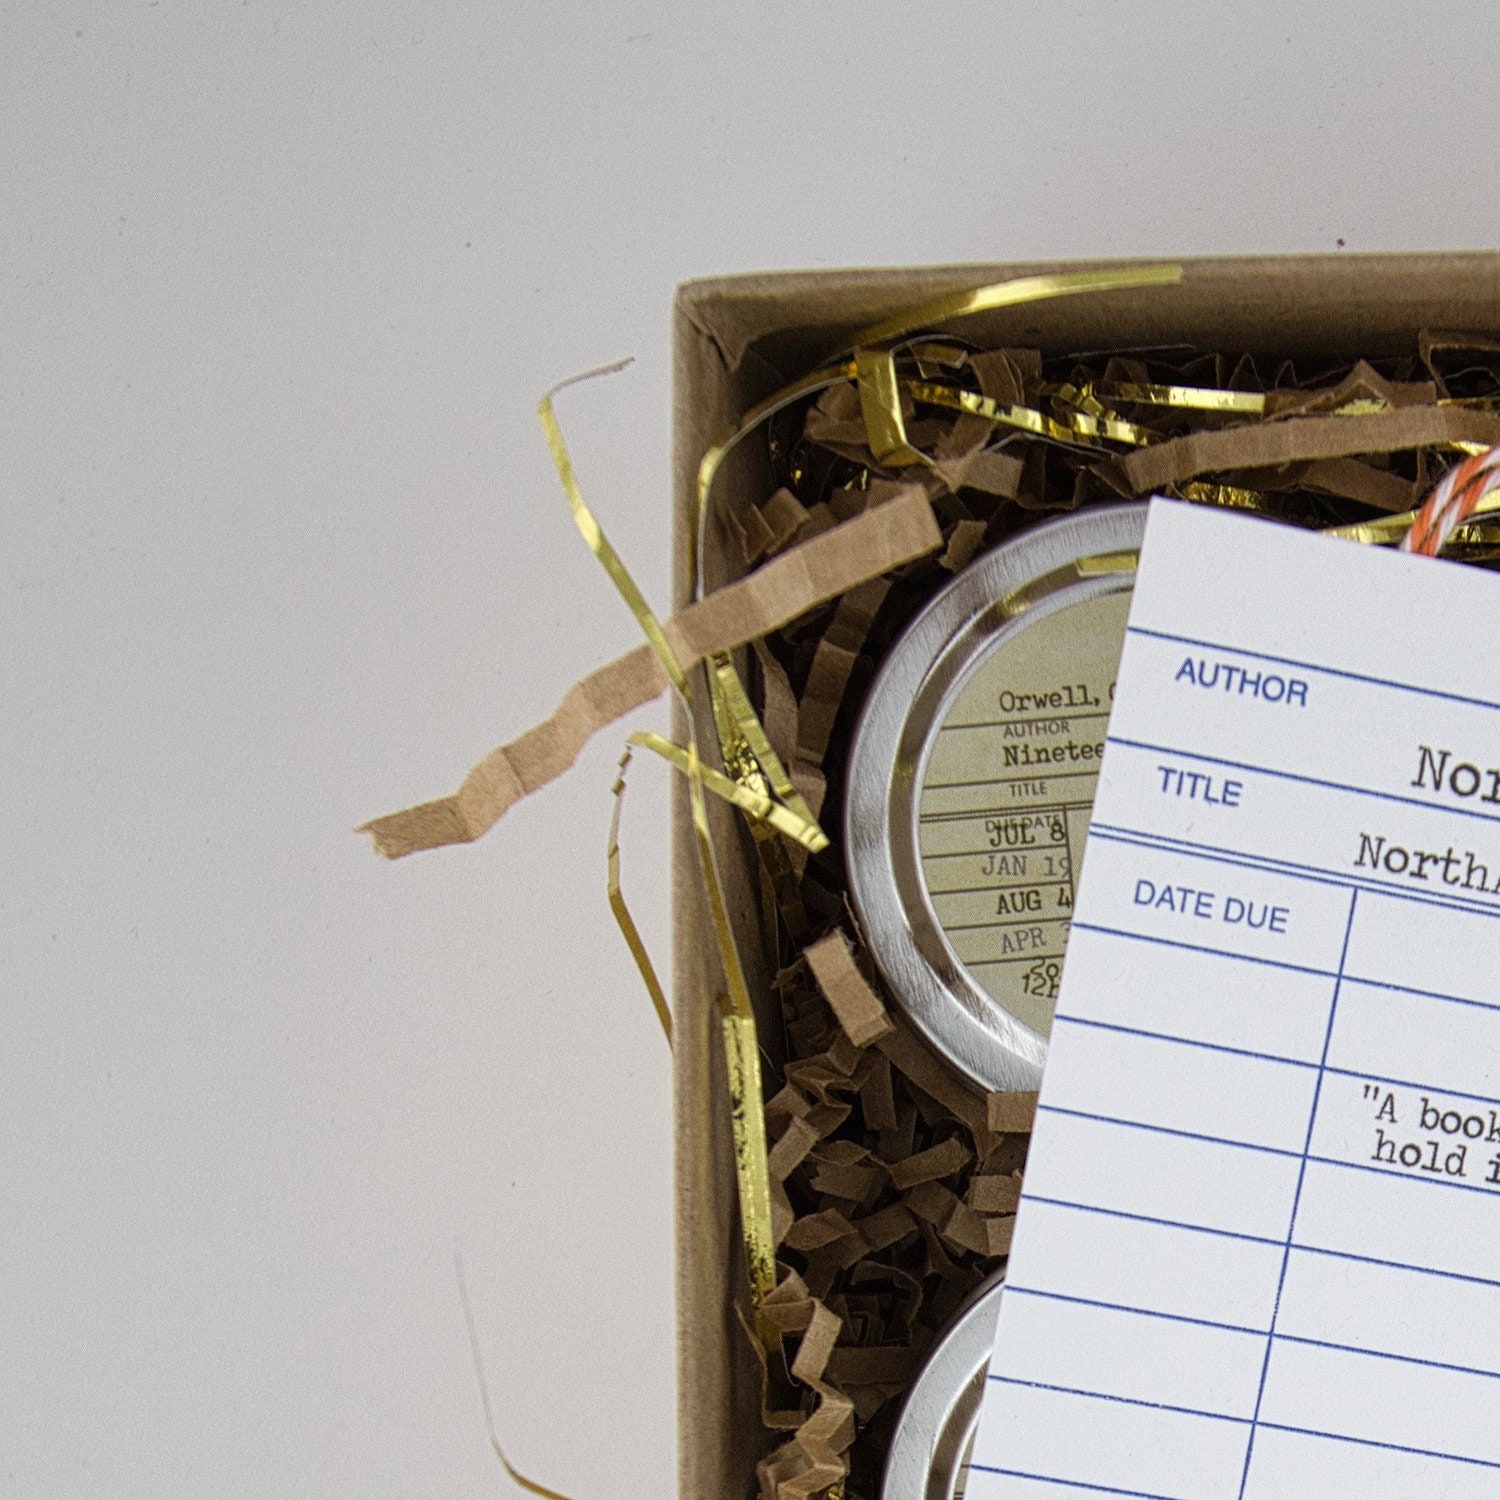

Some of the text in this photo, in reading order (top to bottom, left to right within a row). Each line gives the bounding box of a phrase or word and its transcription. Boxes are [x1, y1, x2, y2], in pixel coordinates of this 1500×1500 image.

[1175, 656, 1309, 707] AUTHOR
[999, 684, 1100, 713] Orwell,
[1002, 720, 1071, 739] AUTHOR
[1009, 781, 1048, 797] TITLE
[1157, 765, 1243, 808] TITLE
[989, 822, 1066, 848] JUL 8
[981, 854, 1071, 879] JAN 19
[996, 886, 1073, 916] AUG 4
[1133, 878, 1290, 934] DATE DUE
[1001, 926, 1047, 955] APR
[1029, 957, 1062, 980] 2o
[1363, 1084, 1398, 1124] "A
[1371, 1129, 1467, 1178] hold
